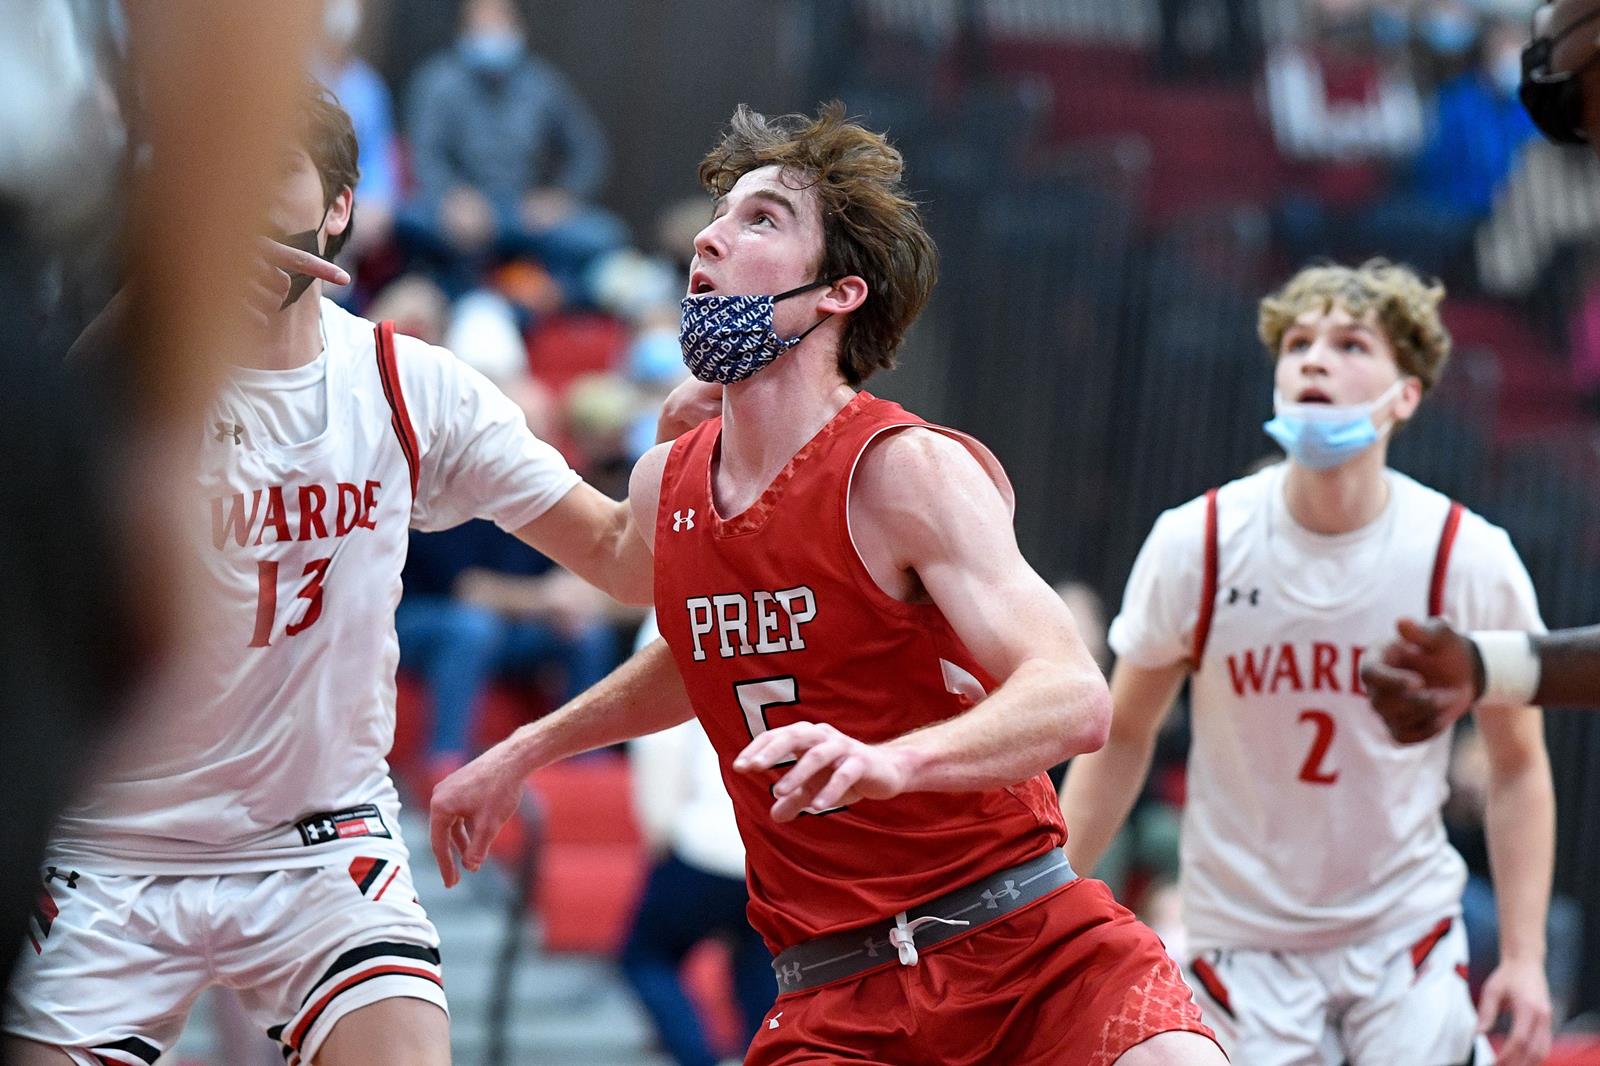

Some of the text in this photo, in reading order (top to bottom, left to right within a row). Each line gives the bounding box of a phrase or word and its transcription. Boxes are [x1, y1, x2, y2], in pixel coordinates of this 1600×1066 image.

[211, 480, 381, 551] WARDE
[247, 557, 331, 648] 13
[686, 585, 818, 662] PREP
[1227, 641, 1369, 697] WAR
[1297, 708, 1340, 786] 2
